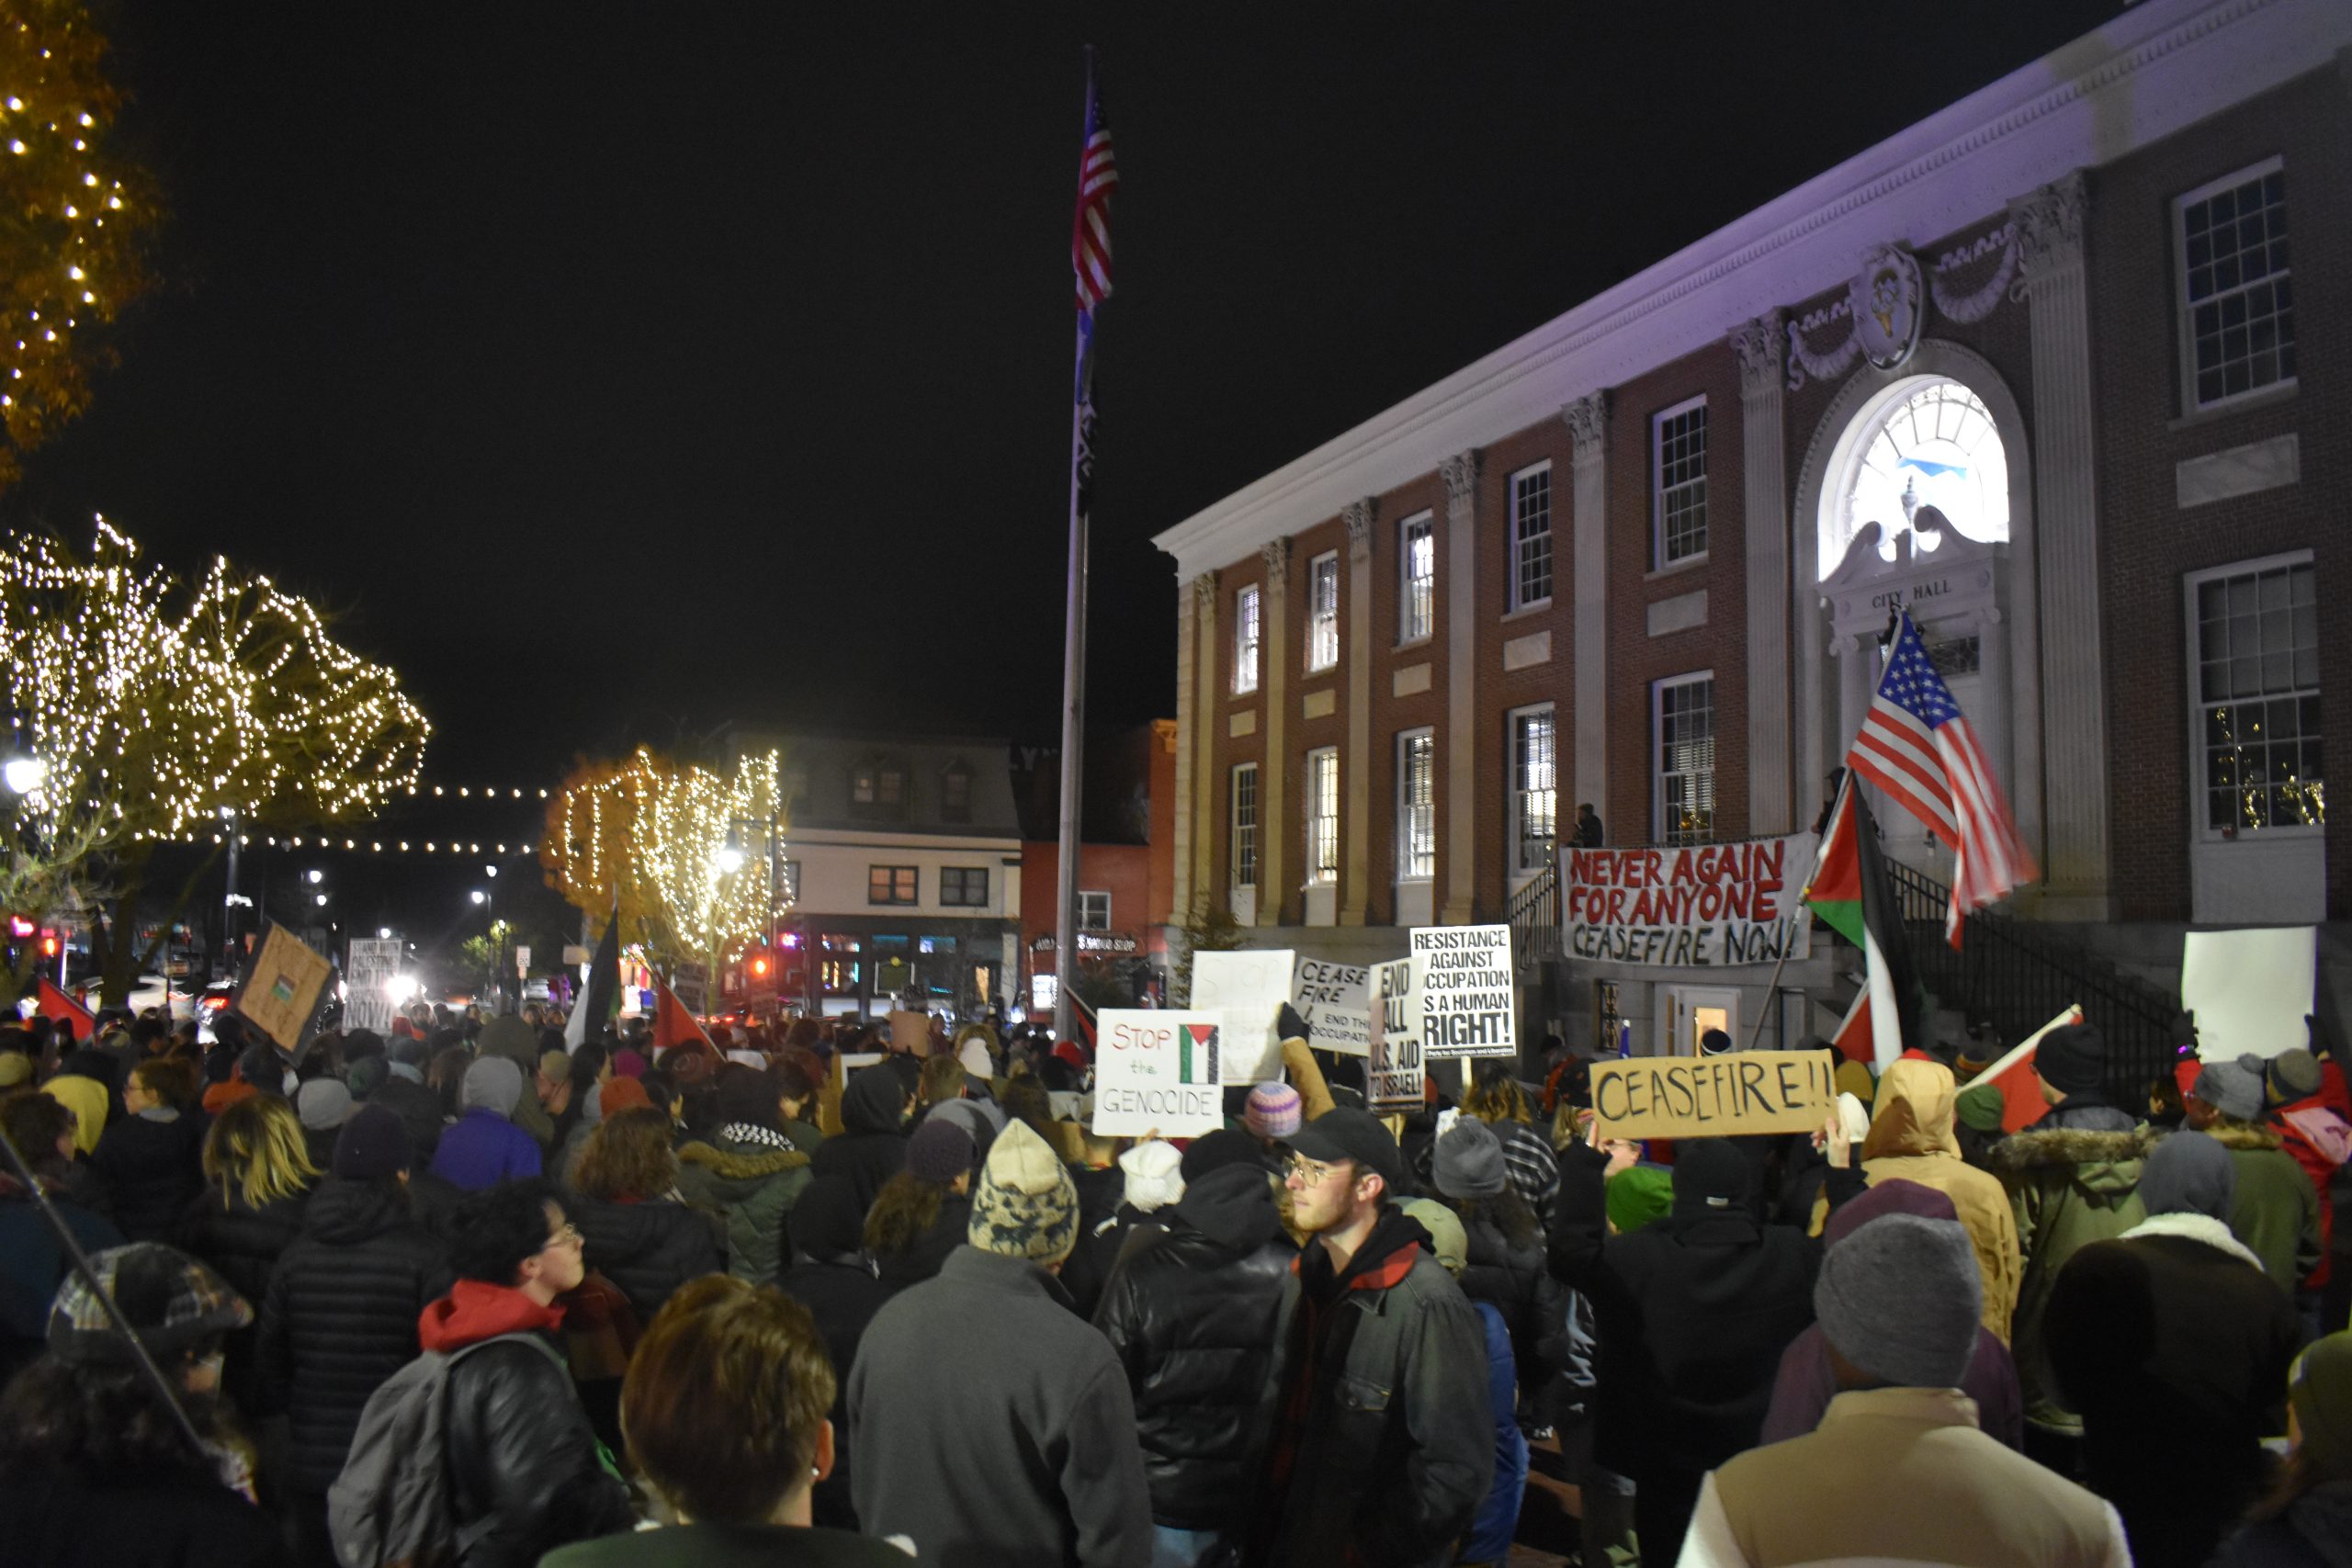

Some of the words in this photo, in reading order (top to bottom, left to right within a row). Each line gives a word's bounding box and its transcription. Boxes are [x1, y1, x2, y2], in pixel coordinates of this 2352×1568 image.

[1871, 589, 1904, 609] CITY
[1913, 579, 1951, 600] HALL
[1570, 849, 1662, 888] NEVER
[1670, 840, 1785, 886] AGAIN
[1569, 886, 1626, 924] FOR
[1628, 879, 1783, 926] ANYONE
[1414, 930, 1507, 950] RESISTANCE
[1573, 924, 1713, 964] CEASEFIRE
[1430, 950, 1494, 969] AGAINST
[1301, 961, 1368, 987] CEASE
[1382, 962, 1409, 999] END
[1423, 970, 1510, 989] CCUPATION
[1297, 984, 1346, 1004] FIRE
[1439, 995, 1449, 1011] A
[1453, 992, 1510, 1010] HUMAN
[1324, 1012, 1349, 1026] END
[1383, 998, 1408, 1035] ALL
[1423, 1011, 1510, 1046] RIGHT!
[1112, 1023, 1171, 1051] STOP
[1130, 1059, 1158, 1075] the
[1397, 1039, 1419, 1071] AID
[1383, 1072, 1421, 1098] ISRAEL!
[1596, 1060, 1831, 1123] CEASEFIRE!!
[1103, 1089, 1214, 1117] GENOCIDE
